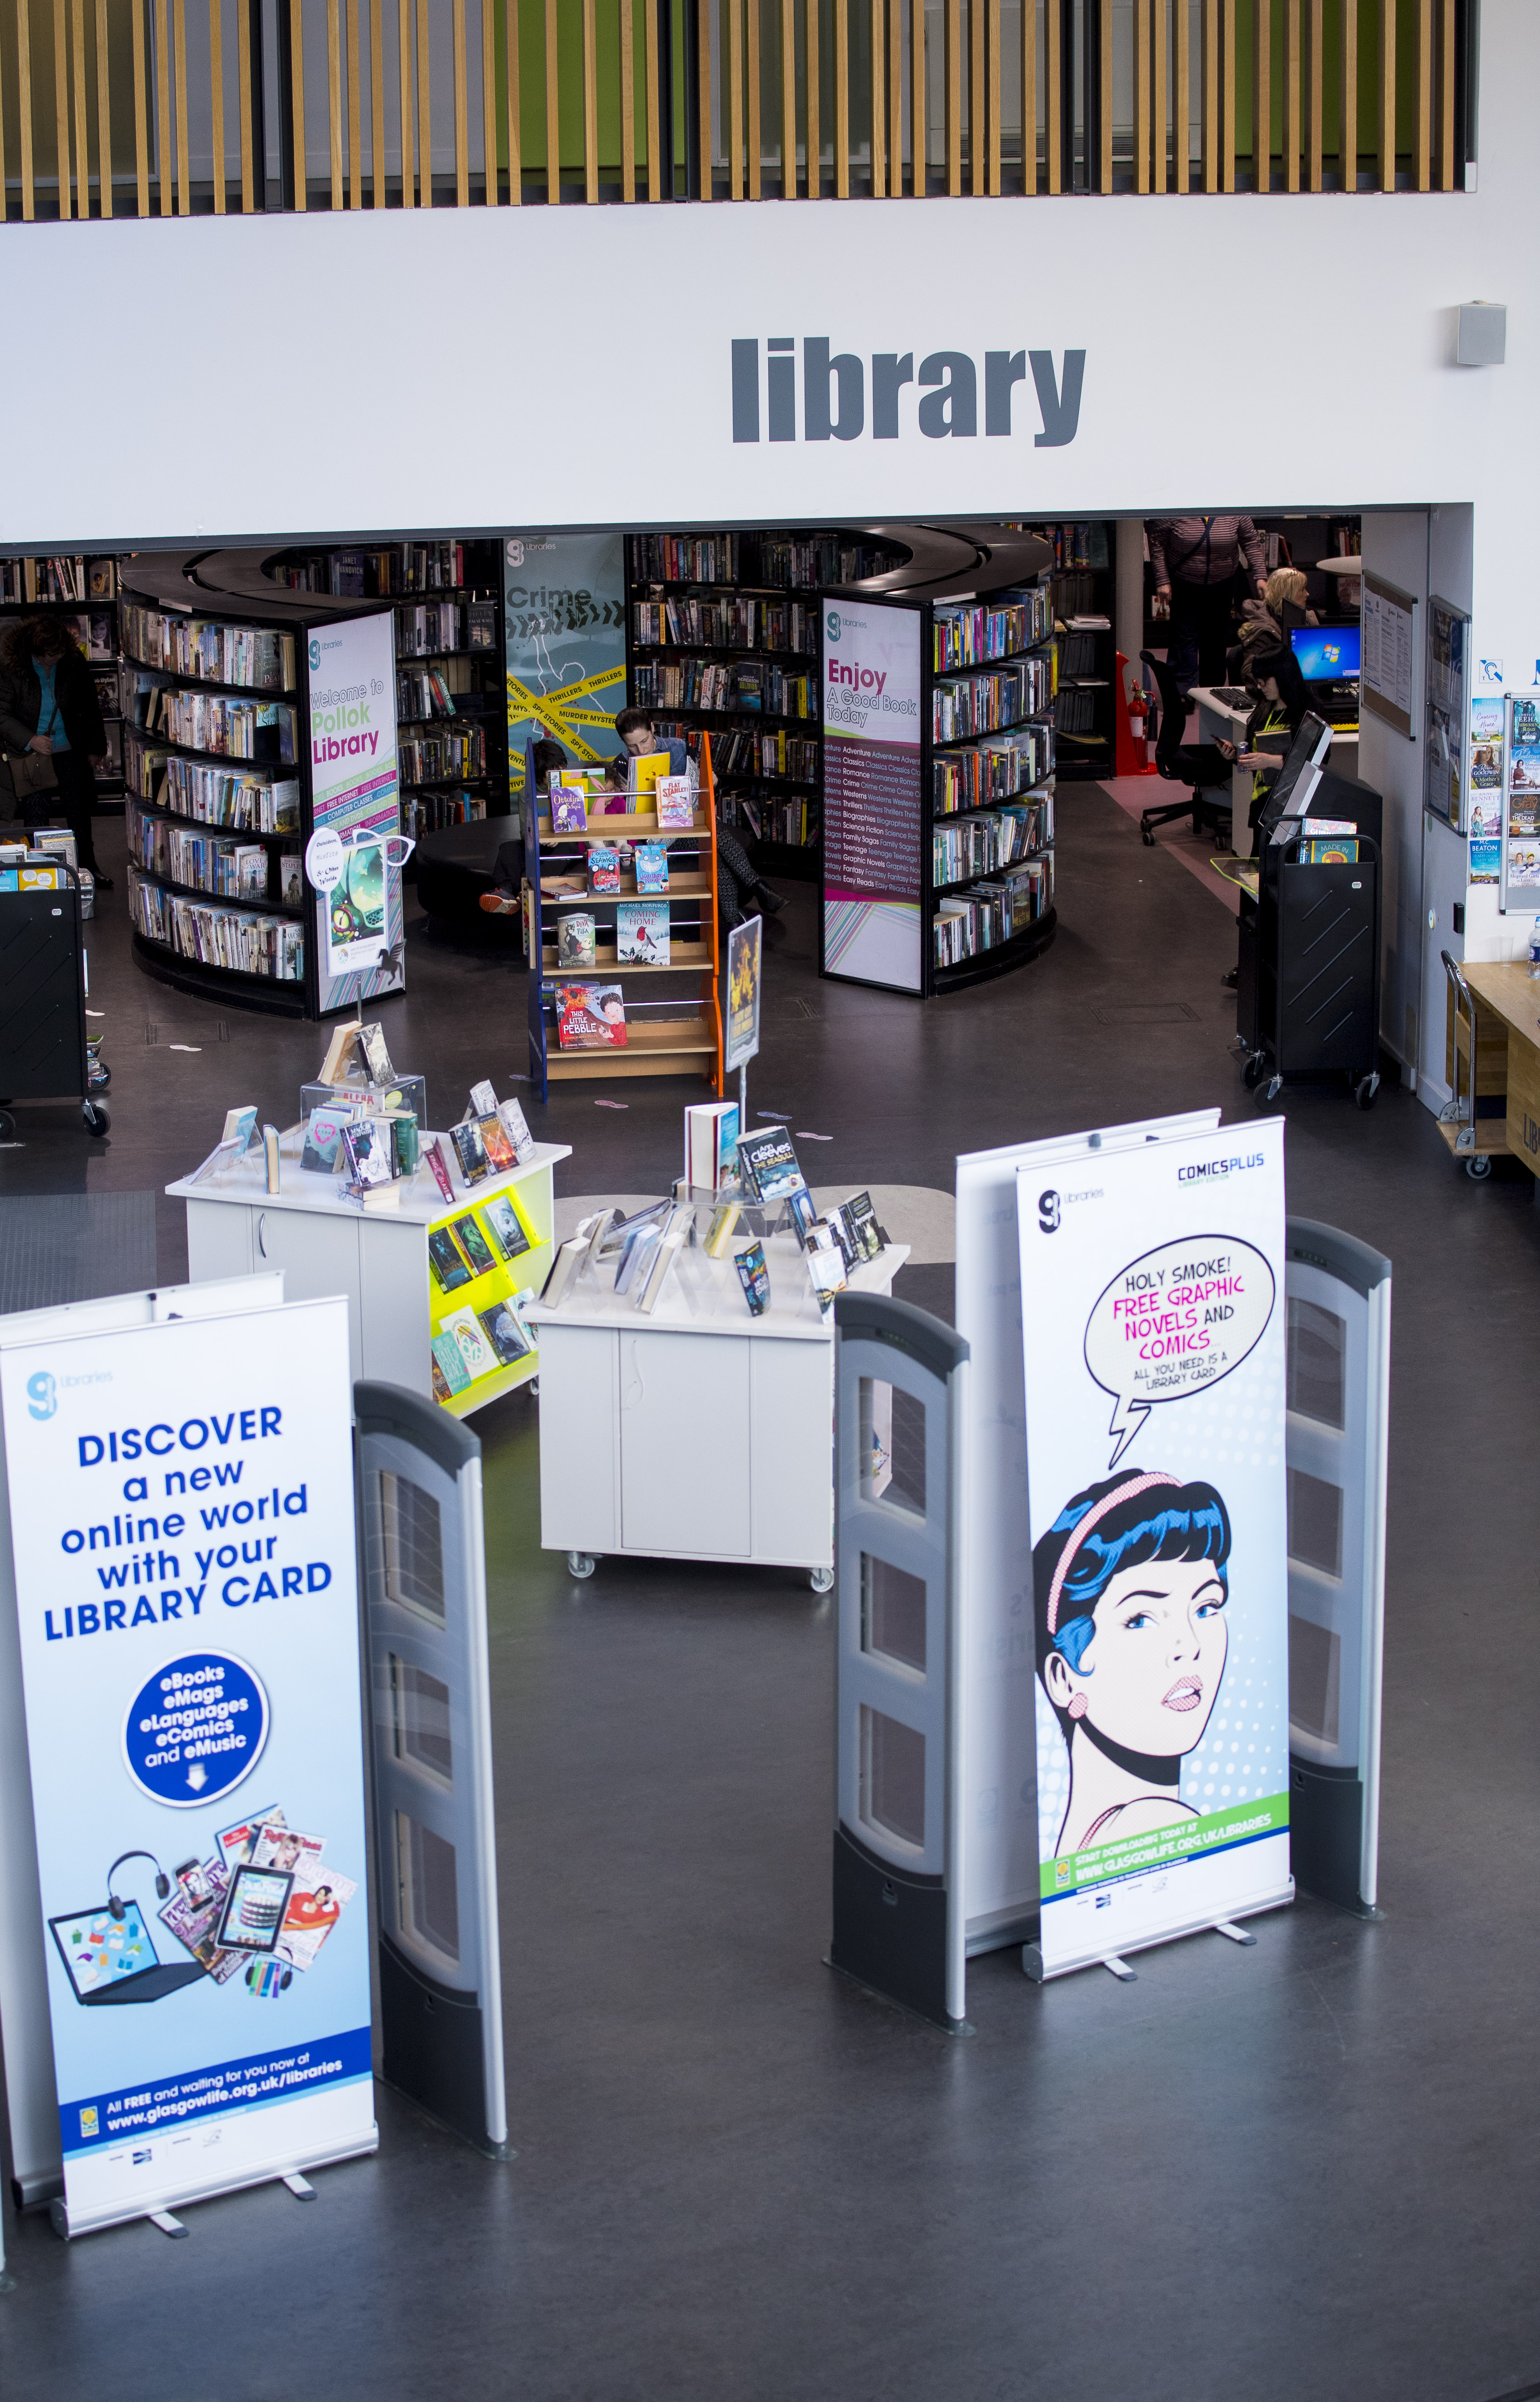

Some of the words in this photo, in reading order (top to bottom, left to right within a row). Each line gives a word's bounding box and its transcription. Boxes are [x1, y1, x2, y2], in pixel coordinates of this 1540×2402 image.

[731, 337, 1086, 447] library
[507, 586, 591, 608] Crime
[843, 618, 867, 628] libraries
[322, 640, 343, 650] libraries
[740, 682, 757, 690] OBLIVION
[829, 659, 887, 695] Enjoy
[310, 683, 367, 710] Welcome
[370, 679, 383, 695] to
[548, 686, 582, 704] THRILLERS
[588, 671, 622, 688] THRILLERS
[827, 687, 838, 703] A
[841, 689, 879, 710] Good
[883, 695, 916, 715] Book
[312, 701, 371, 737] Pollok
[559, 711, 588, 720] MURDER
[827, 704, 868, 727] Today
[1477, 712, 1498, 721] Coming
[1479, 720, 1495, 729] Home
[532, 703, 545, 714] SPY
[543, 714, 566, 735] STORIES
[571, 739, 583, 749] SPY
[313, 730, 379, 764] Library
[843, 746, 871, 757] Adventure
[843, 757, 864, 767] Classics
[843, 768, 870, 778] Romance
[326, 784, 343, 797] BOOKS
[327, 799, 338, 809] FREE
[338, 789, 358, 804] INTERNET
[361, 784, 372, 793] FREE
[373, 774, 392, 788] INTERNET
[663, 787, 688, 797] STANLEY!
[843, 779, 859, 787] Crime
[861, 782, 878, 790] Crime
[843, 789, 867, 799] Westerns
[328, 804, 353, 820] COMPUTER
[353, 794, 373, 809] CLASSES
[843, 800, 863, 809] Thrillers
[864, 804, 883, 813] Thrillers
[1512, 798, 1538, 810] Gray
[339, 817, 350, 828] AND
[351, 811, 363, 822] DVDS
[843, 811, 876, 823] Biographies
[843, 822, 864, 832] Science
[866, 826, 884, 835] Fiction
[843, 833, 861, 843] Family
[862, 836, 879, 845] Sagas
[316, 851, 338, 860] Misfits
[843, 844, 867, 854] Teenage
[1341, 845, 1349, 854] IN
[843, 854, 866, 865] Graphic
[867, 859, 885, 868] Novels
[843, 865, 864, 875] Fantasy
[319, 876, 337, 885] Worlds
[843, 876, 855, 885] Easy
[857, 878, 874, 887] Reads
[563, 1023, 597, 1034] PEBBLE
[350, 1124, 372, 1134] MAGGIE
[751, 1142, 791, 1163] Cleeves
[760, 1143, 774, 1152] Ann
[429, 1155, 438, 1169] KING
[767, 1152, 794, 1166] SEAGULL
[1064, 1187, 1104, 1205] libraries
[1126, 1269, 1165, 1293] HOLY
[1172, 1256, 1231, 1284] SMOKE!
[1113, 1292, 1160, 1320] FREE
[1167, 1276, 1244, 1307] GRAPHIC
[1125, 1308, 1198, 1341] NOVELS
[1204, 1305, 1234, 1325] AND
[1134, 1369, 1150, 1382] ALL
[1155, 1361, 1176, 1376] YOU
[1179, 1356, 1204, 1371] NEED
[1208, 1353, 1218, 1365] IS
[1222, 1351, 1228, 1362] A
[61, 1370, 113, 1389] libraries
[1146, 1373, 1188, 1390] LIBRARY
[1190, 1367, 1216, 1382] CARD
[78, 1406, 283, 1467] DISCOVER
[123, 1474, 148, 1502] a
[165, 1460, 244, 1497] new
[61, 1513, 185, 1554] online
[200, 1484, 308, 1531] world
[97, 1549, 180, 1590] with
[194, 1535, 277, 1581] your
[45, 1583, 207, 1641] LIBRARY
[222, 1562, 333, 1608] CARD
[160, 1665, 225, 1692] eBooks
[163, 1682, 224, 1710] eMags
[139, 1697, 249, 1733] eLanguages
[155, 1718, 235, 1747] eComics
[144, 1746, 180, 1767] and
[184, 1733, 247, 1760] eMusic
[1075, 1851, 1100, 1866] START
[1102, 1833, 1158, 1860] DOWNLOADING
[1160, 1826, 1185, 1841] TODAY
[1187, 1821, 1198, 1833] AT
[106, 2101, 122, 2114] All
[123, 2092, 152, 2110] FREE
[154, 2085, 179, 2102] and
[181, 2073, 224, 2096] waiting
[225, 2068, 242, 2084] for
[244, 2063, 268, 2080] you
[270, 2057, 295, 2072] now
[297, 2051, 310, 2065] at
[107, 2058, 343, 2131] www.glasgowlife.org.uk/libraries
